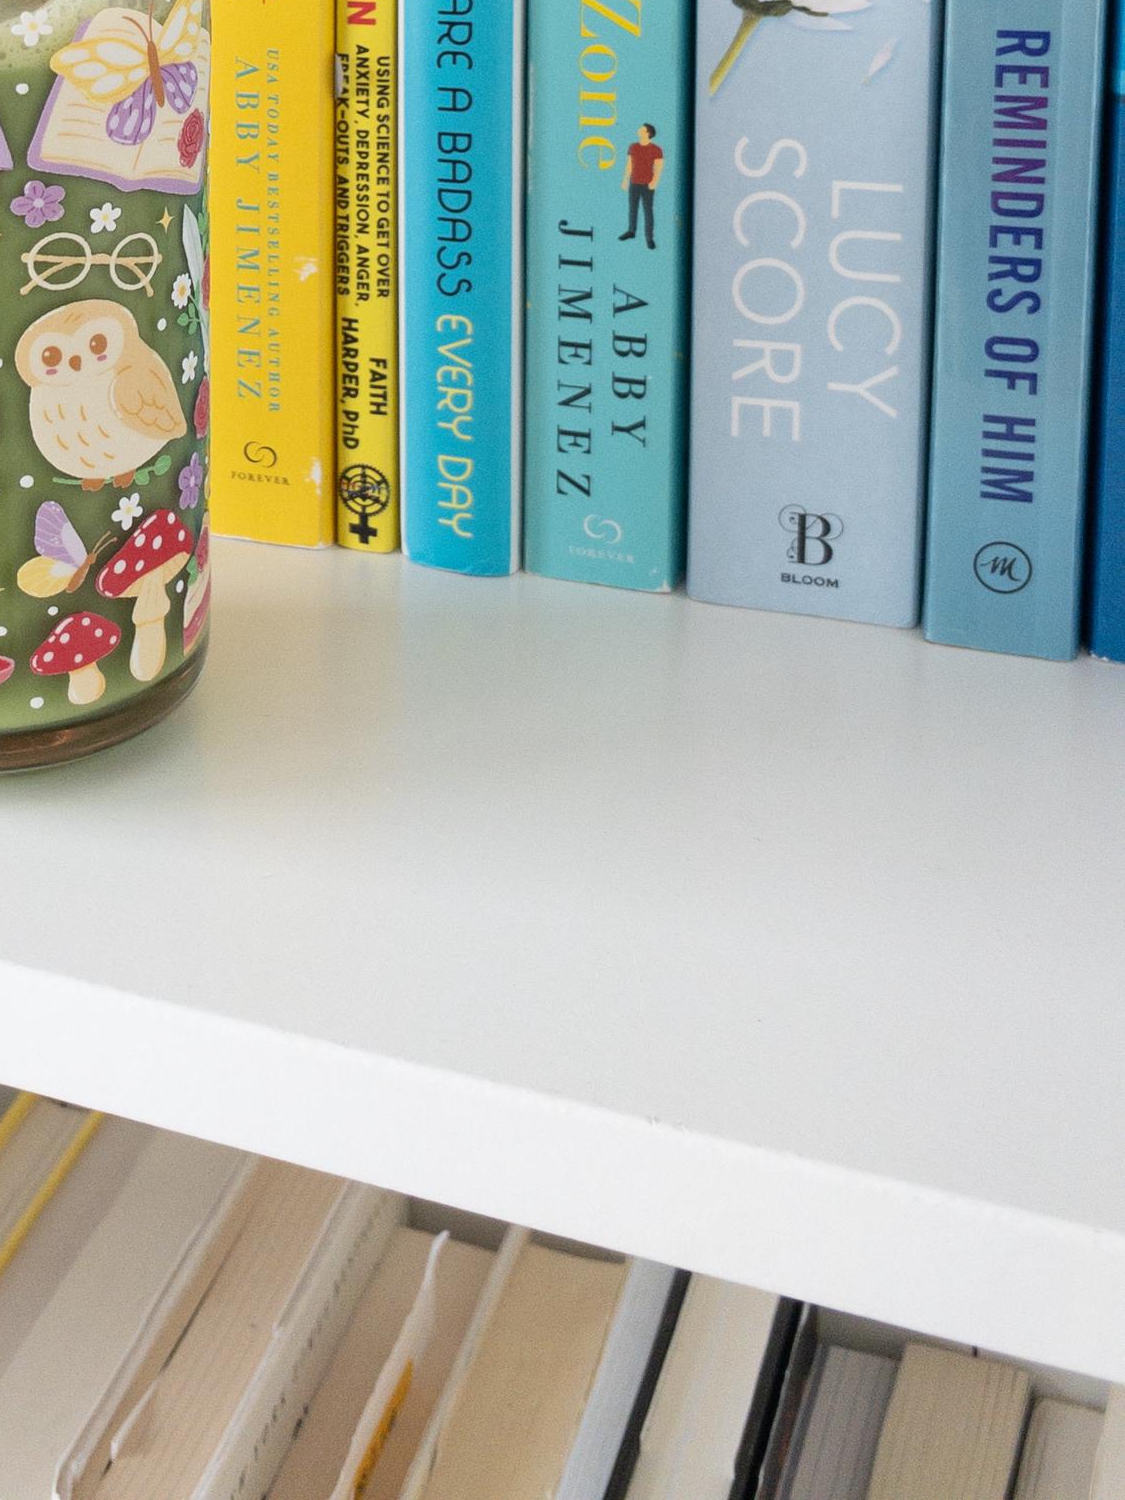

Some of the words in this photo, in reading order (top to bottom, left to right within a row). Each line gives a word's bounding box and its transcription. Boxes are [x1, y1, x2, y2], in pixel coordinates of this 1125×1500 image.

[267, 48, 280, 84] USA
[354, 44, 370, 124] ANXIETY,
[375, 56, 391, 109] USING
[437, 86, 473, 112] A
[235, 56, 260, 174] ABBY
[267, 94, 280, 167] TODAY
[375, 113, 391, 186] SCIENCE
[336, 174, 350, 210] AND
[354, 129, 370, 239] DEPRESSION,
[376, 191, 391, 214] TO
[986, 29, 1052, 316] REMINDERS
[266, 172, 281, 318] BESTSELLING
[336, 213, 350, 297] TRIGGERS
[376, 217, 390, 249] GET
[436, 132, 473, 297] BADASS
[235, 198, 263, 399] JIMENEZ
[355, 244, 370, 306] ANGER,
[376, 253, 390, 299] OVER
[729, 135, 809, 442] SCORE
[826, 180, 904, 419] LUCY
[267, 328, 281, 412] AUTHOR
[340, 316, 360, 403] HARPER,
[369, 357, 388, 416] FAITH
[435, 314, 474, 441] EVERY
[555, 219, 594, 499] JIMENEZ
[610, 284, 649, 449] ABBY
[984, 335, 1040, 396] OF
[341, 409, 360, 450] PhD
[979, 413, 1037, 504] HIM
[230, 470, 291, 486] FOREVER
[436, 454, 474, 539] DAY
[780, 572, 840, 589] BLOOM
